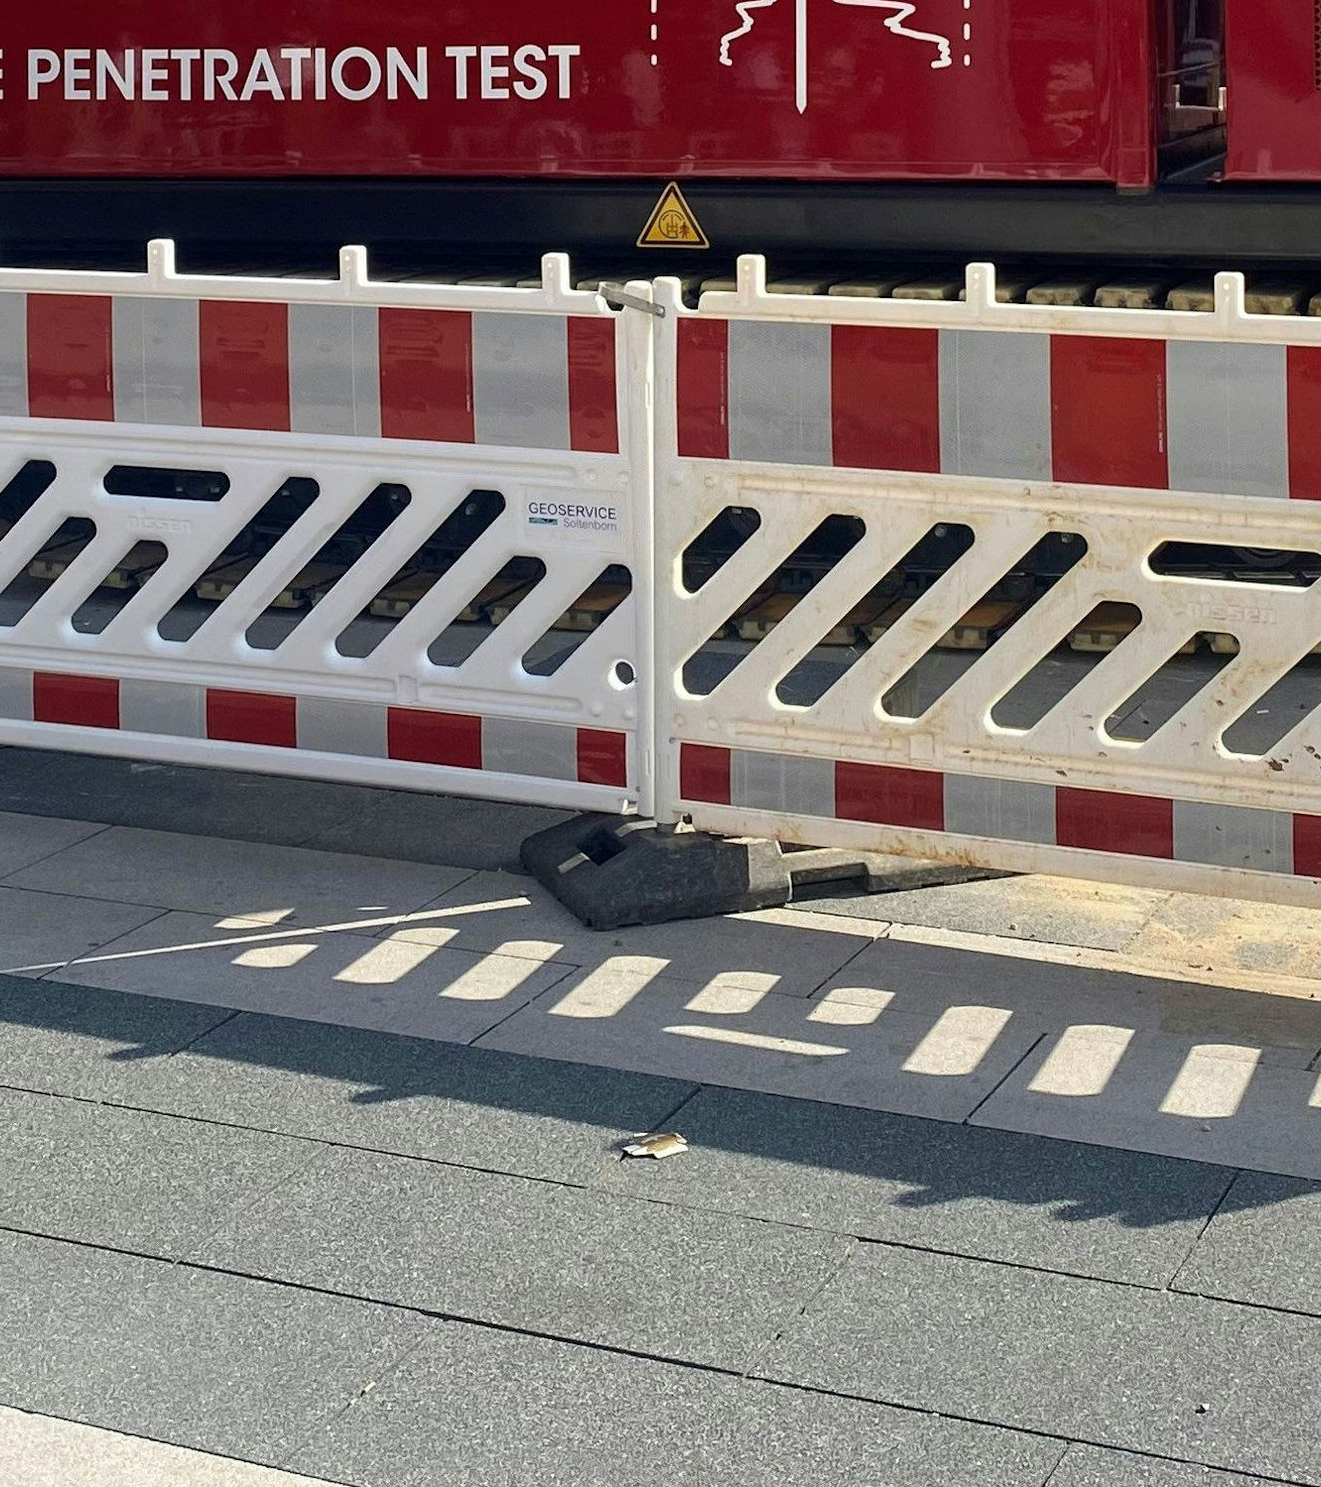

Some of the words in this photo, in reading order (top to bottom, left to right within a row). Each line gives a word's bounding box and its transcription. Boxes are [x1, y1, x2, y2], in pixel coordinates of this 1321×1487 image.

[28, 46, 428, 101] PENETRATION
[445, 44, 581, 100] TEST
[528, 501, 617, 521] GEOSERVICE
